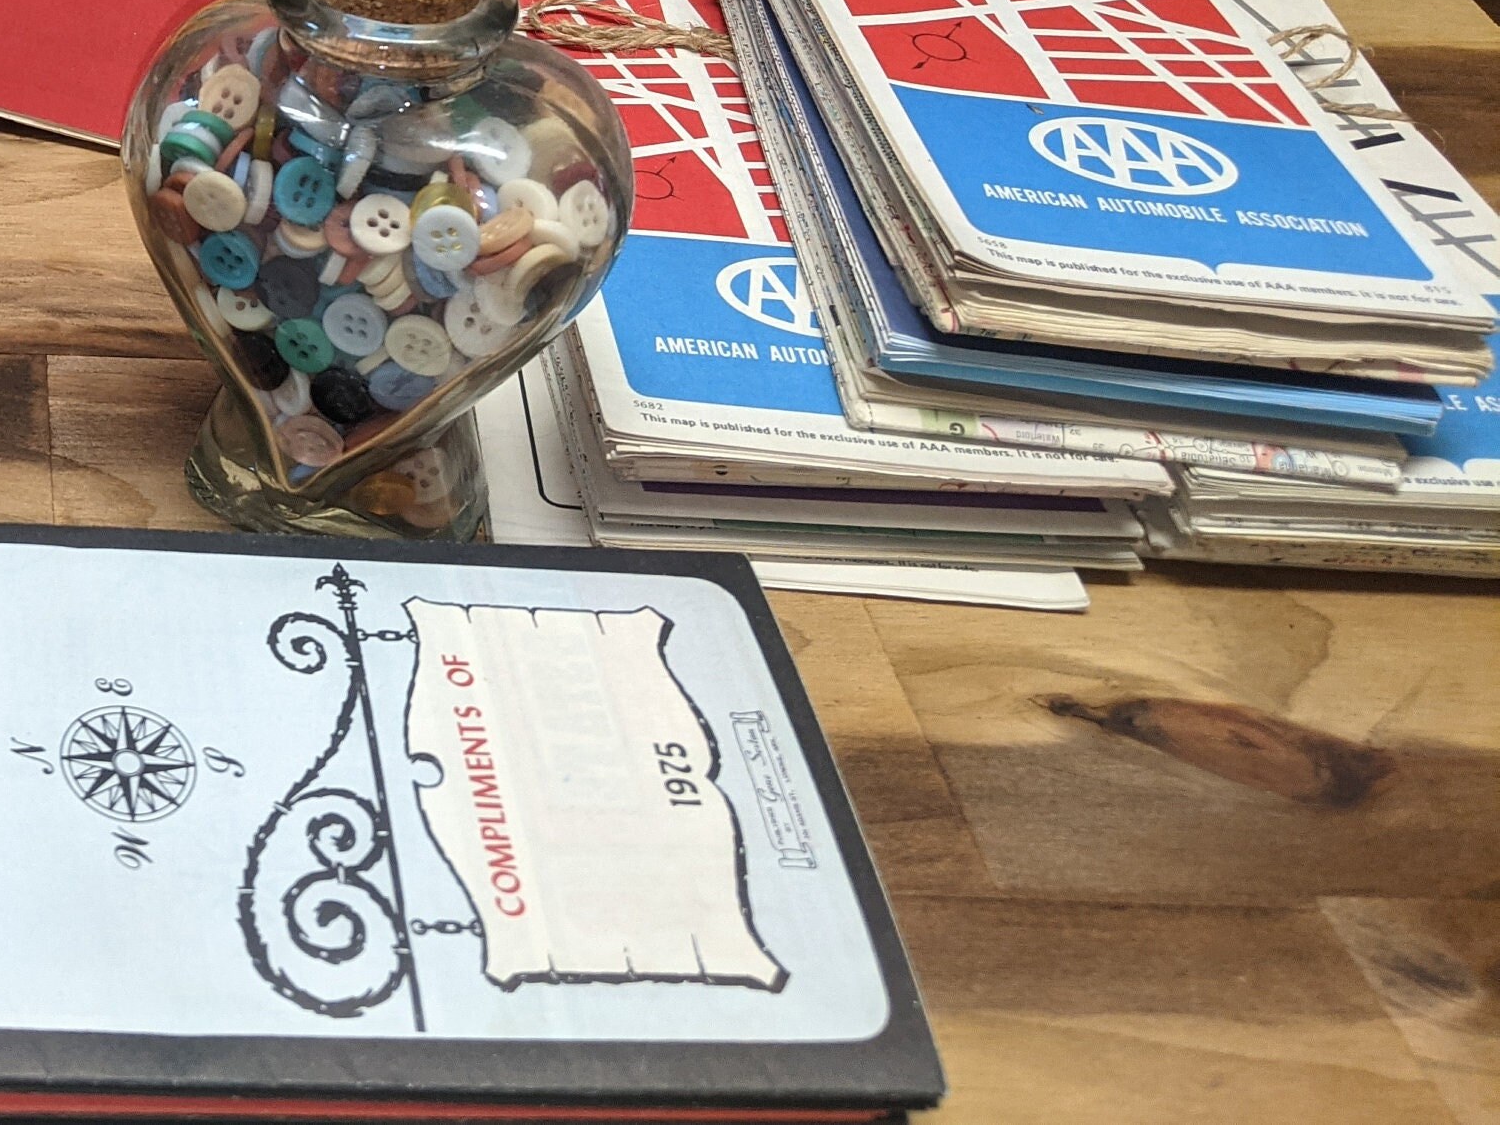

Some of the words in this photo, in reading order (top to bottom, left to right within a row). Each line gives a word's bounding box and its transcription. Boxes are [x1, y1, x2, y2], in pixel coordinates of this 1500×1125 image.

[1046, 120, 1232, 193] AAA
[982, 183, 1089, 209] AMERICAN
[1096, 196, 1228, 224] AUTOMOBILE
[1235, 209, 1370, 238] ASSOCIATION
[987, 248, 1014, 261] This
[1017, 256, 1043, 268] map
[1057, 261, 1117, 275] published
[1120, 266, 1140, 276] for
[1142, 270, 1163, 280] the
[1165, 273, 1222, 285] exclusive
[1224, 278, 1245, 287] use
[1247, 280, 1262, 289] of
[1264, 281, 1297, 292] AAA
[1299, 286, 1357, 298] members.
[1388, 293, 1409, 303] not
[1412, 294, 1432, 304] for
[655, 336, 759, 360] AMERICAN
[633, 400, 665, 411] 5682
[949, 422, 965, 436] G
[640, 412, 668, 424] This
[671, 418, 696, 429] map
[713, 421, 771, 436] published
[774, 427, 793, 437] for
[796, 430, 816, 440] the
[819, 433, 875, 446] exclusive
[878, 440, 899, 449] use
[901, 440, 915, 450] of
[919, 442, 951, 452] AAA
[954, 446, 1014, 457] members.
[1016, 448, 1029, 458] It
[1045, 451, 1065, 460] not
[1069, 452, 1089, 462] for
[1015, 429, 1061, 443] Waterford
[442, 652, 474, 688] OF
[653, 740, 702, 809] 1975
[454, 703, 526, 919] COMPLIMENTS
